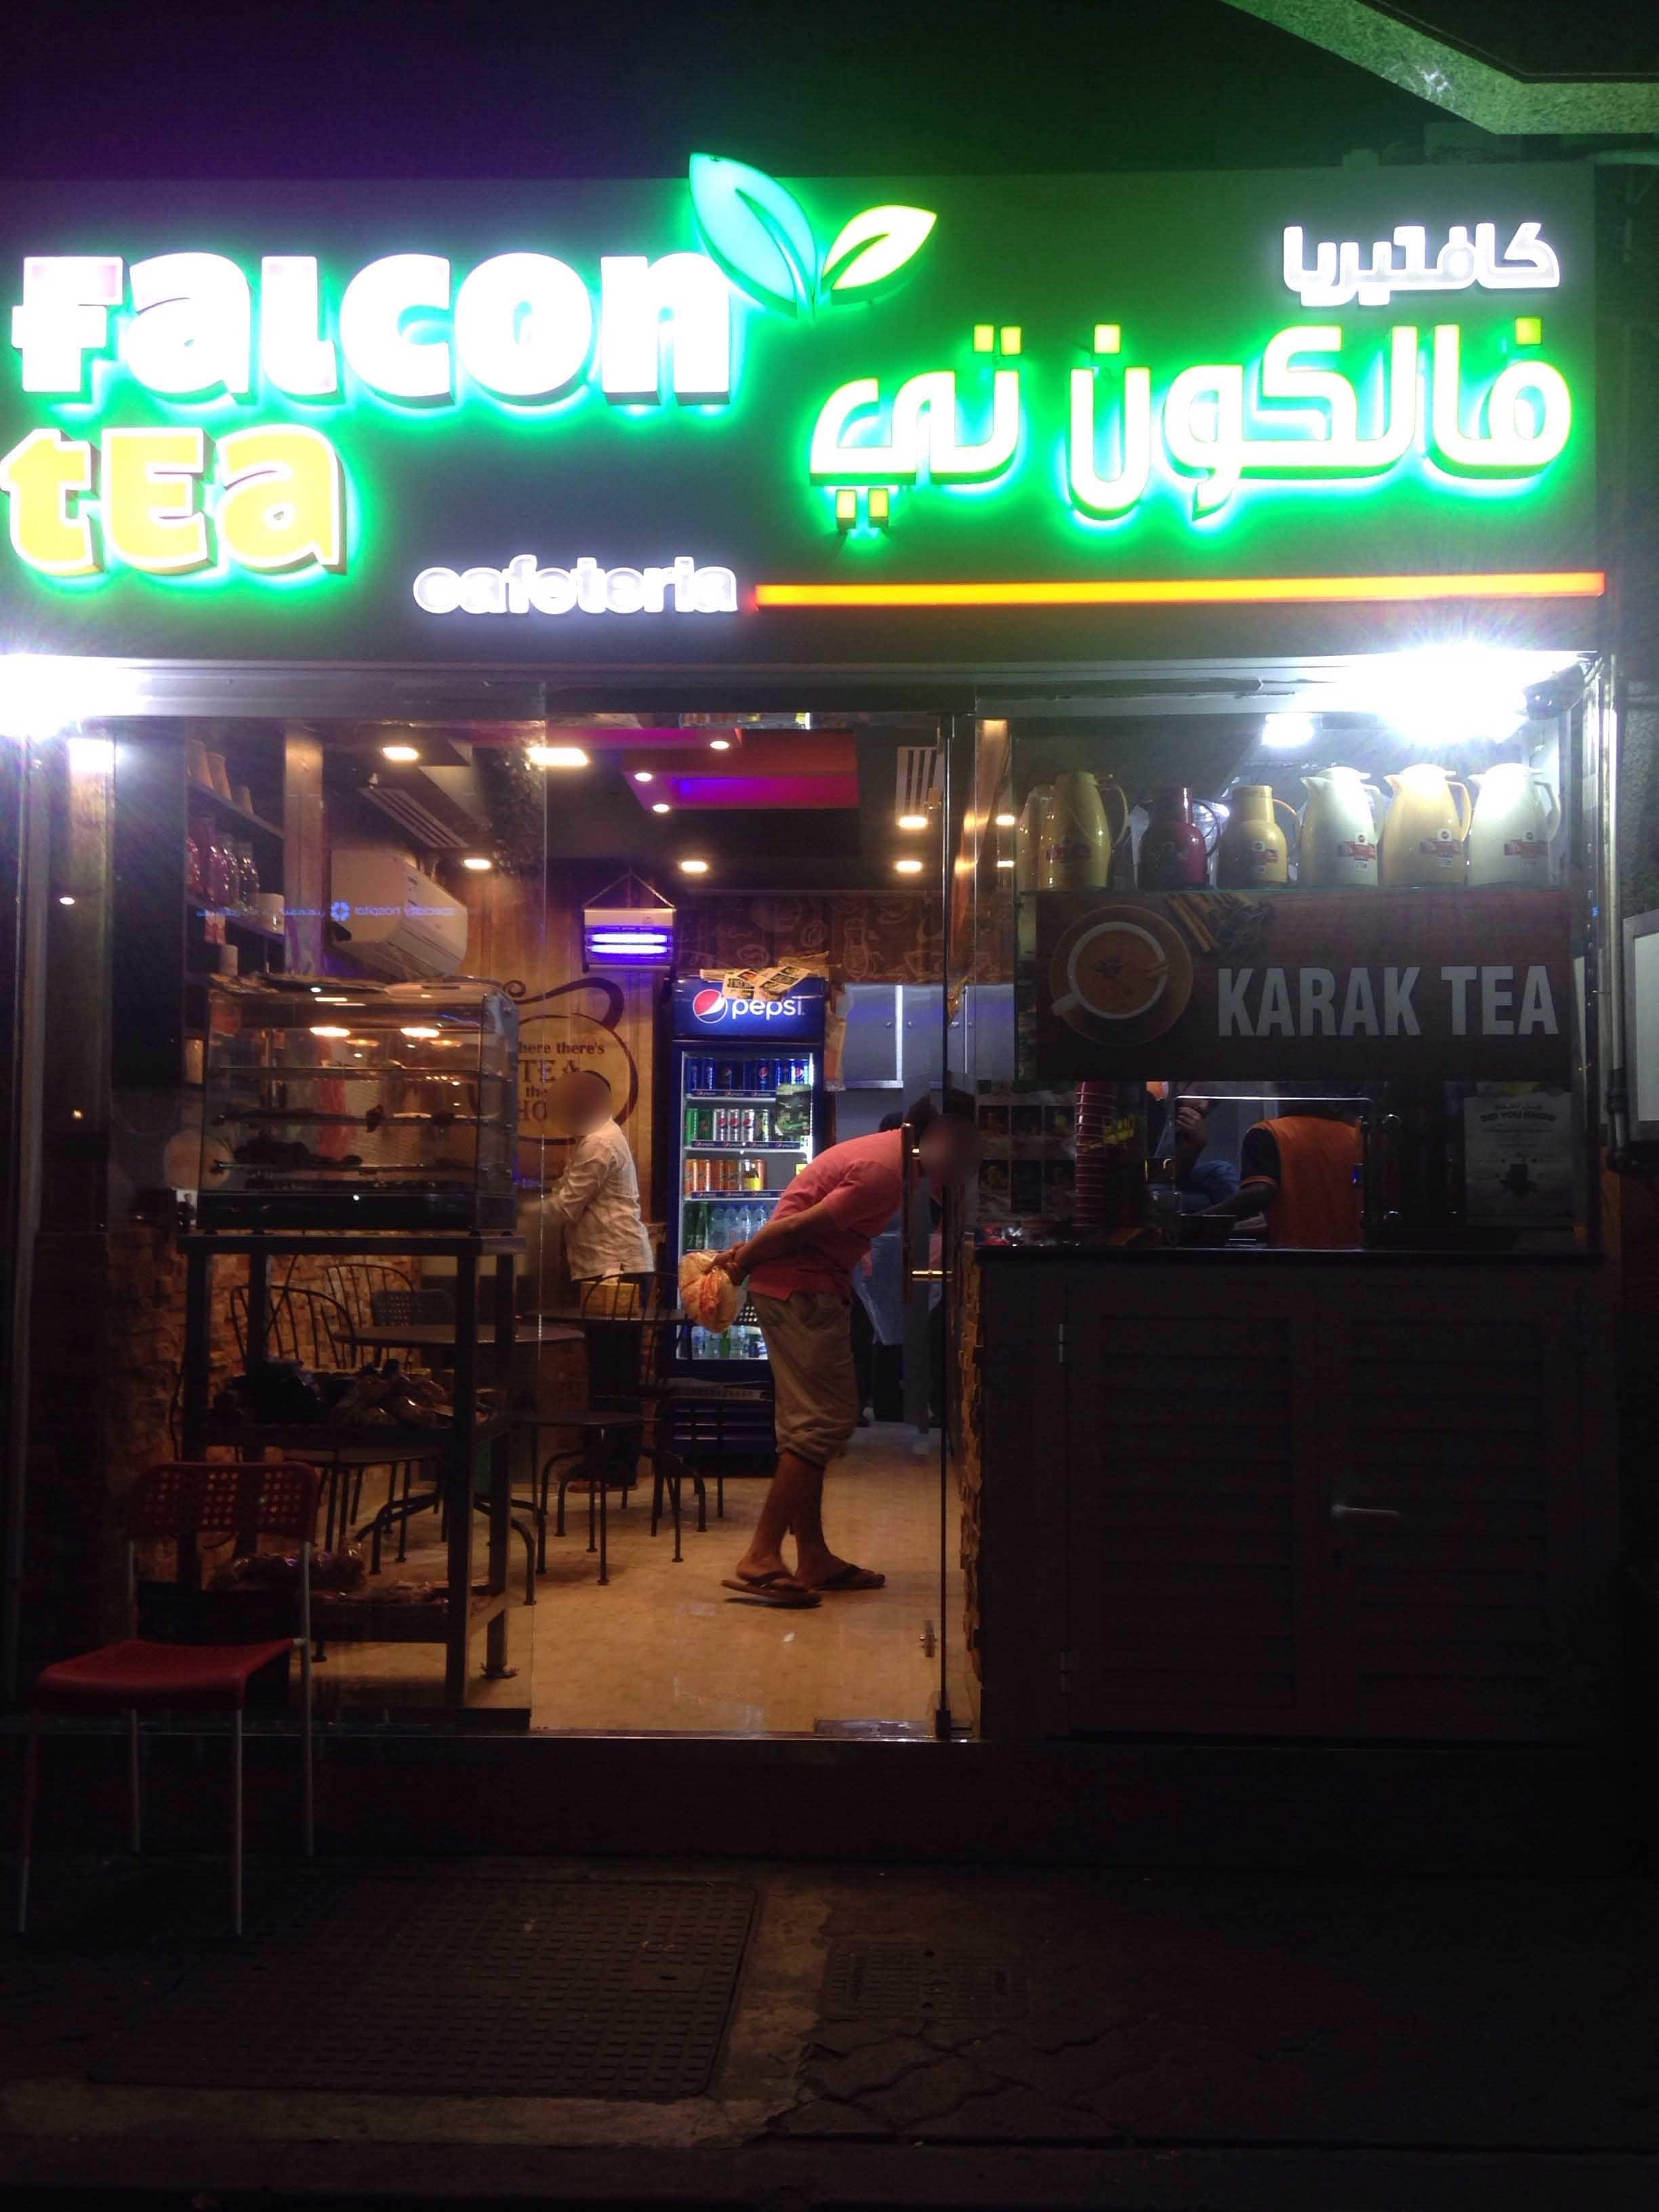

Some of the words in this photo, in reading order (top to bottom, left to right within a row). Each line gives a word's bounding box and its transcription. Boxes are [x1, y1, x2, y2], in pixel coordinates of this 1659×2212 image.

[809, 323, 1022, 531] تي
[1068, 316, 1572, 521] فالكون
[732, 998, 804, 1020] pepsi
[1218, 966, 1422, 1036] KARAK
[1441, 964, 1559, 1036] TEA
[518, 1042, 551, 1053] here
[556, 1042, 605, 1054] there's
